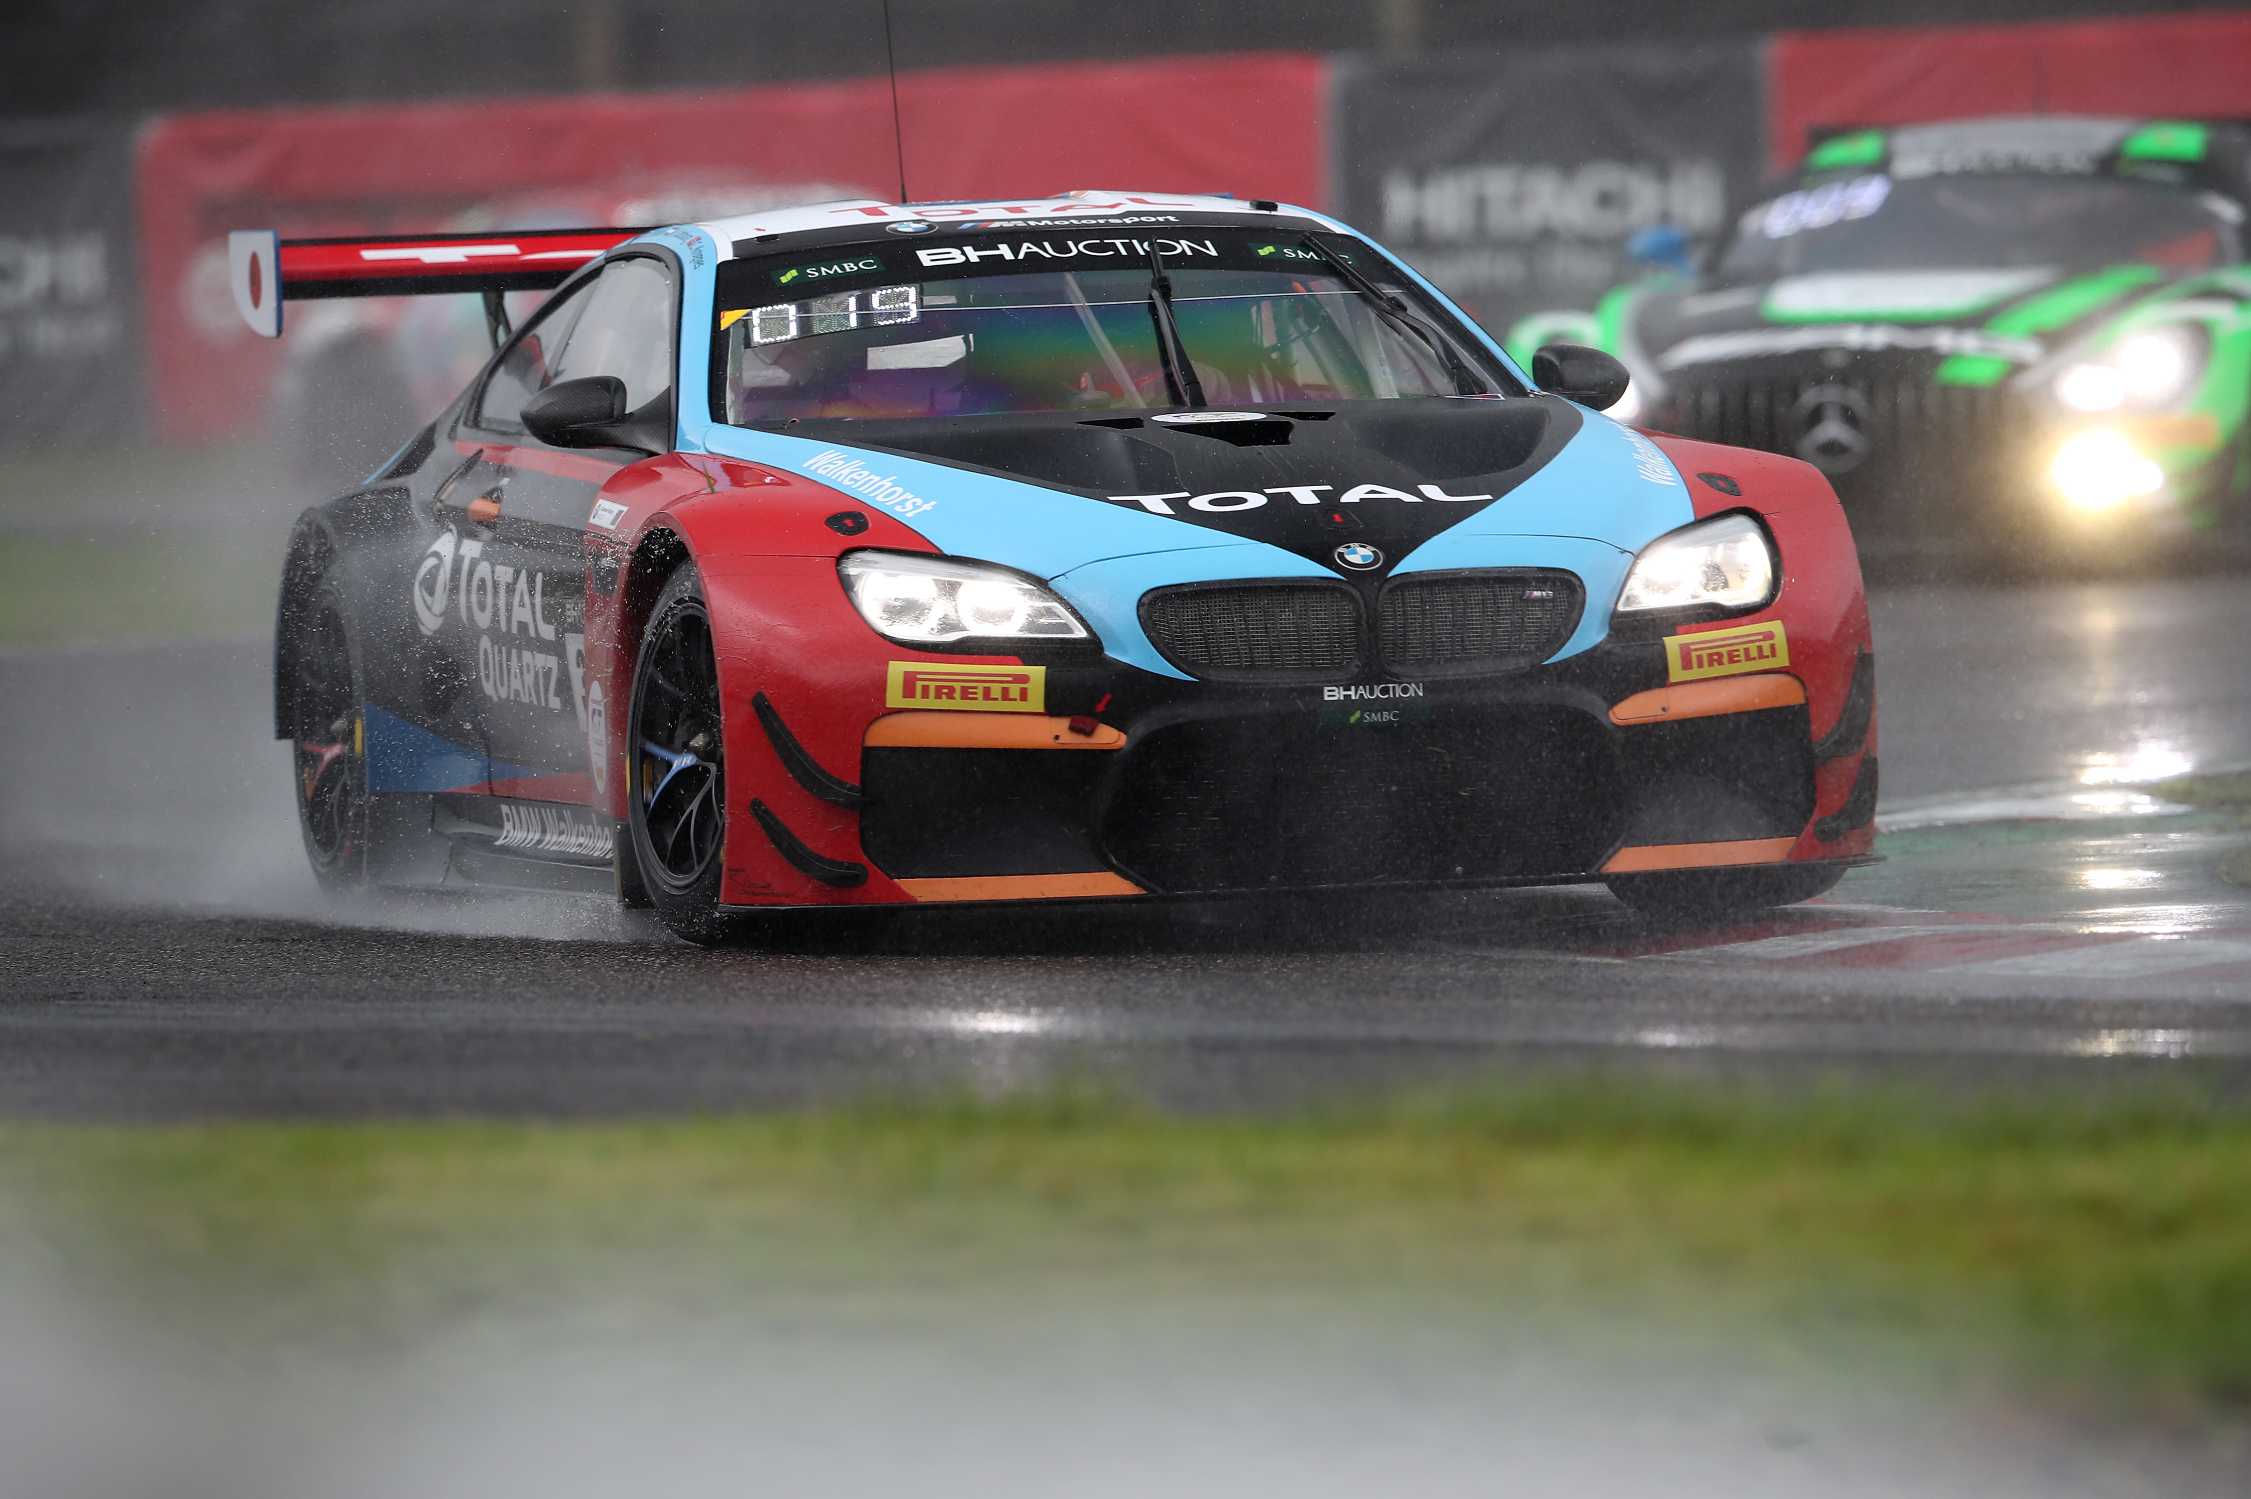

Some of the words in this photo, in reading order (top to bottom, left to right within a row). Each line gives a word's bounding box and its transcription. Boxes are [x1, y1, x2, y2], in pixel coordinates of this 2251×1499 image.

[829, 195, 1194, 218] TOTAL
[1028, 215, 1180, 227] Motorsport
[915, 239, 1219, 267] BHAUCTION
[1283, 247, 1353, 264] SM
[806, 259, 878, 279] SMBC
[751, 286, 918, 344] 019
[802, 449, 937, 518] Walkenhorst
[1106, 484, 1494, 515] TOTAL
[458, 539, 556, 641] TOTAL
[1678, 630, 1777, 671] PIRELLI
[479, 634, 561, 710] QUARTZ
[902, 670, 1031, 702] PIRELLI
[1323, 682, 1424, 701] BHAUCTION
[1362, 710, 1400, 723] SMBC
